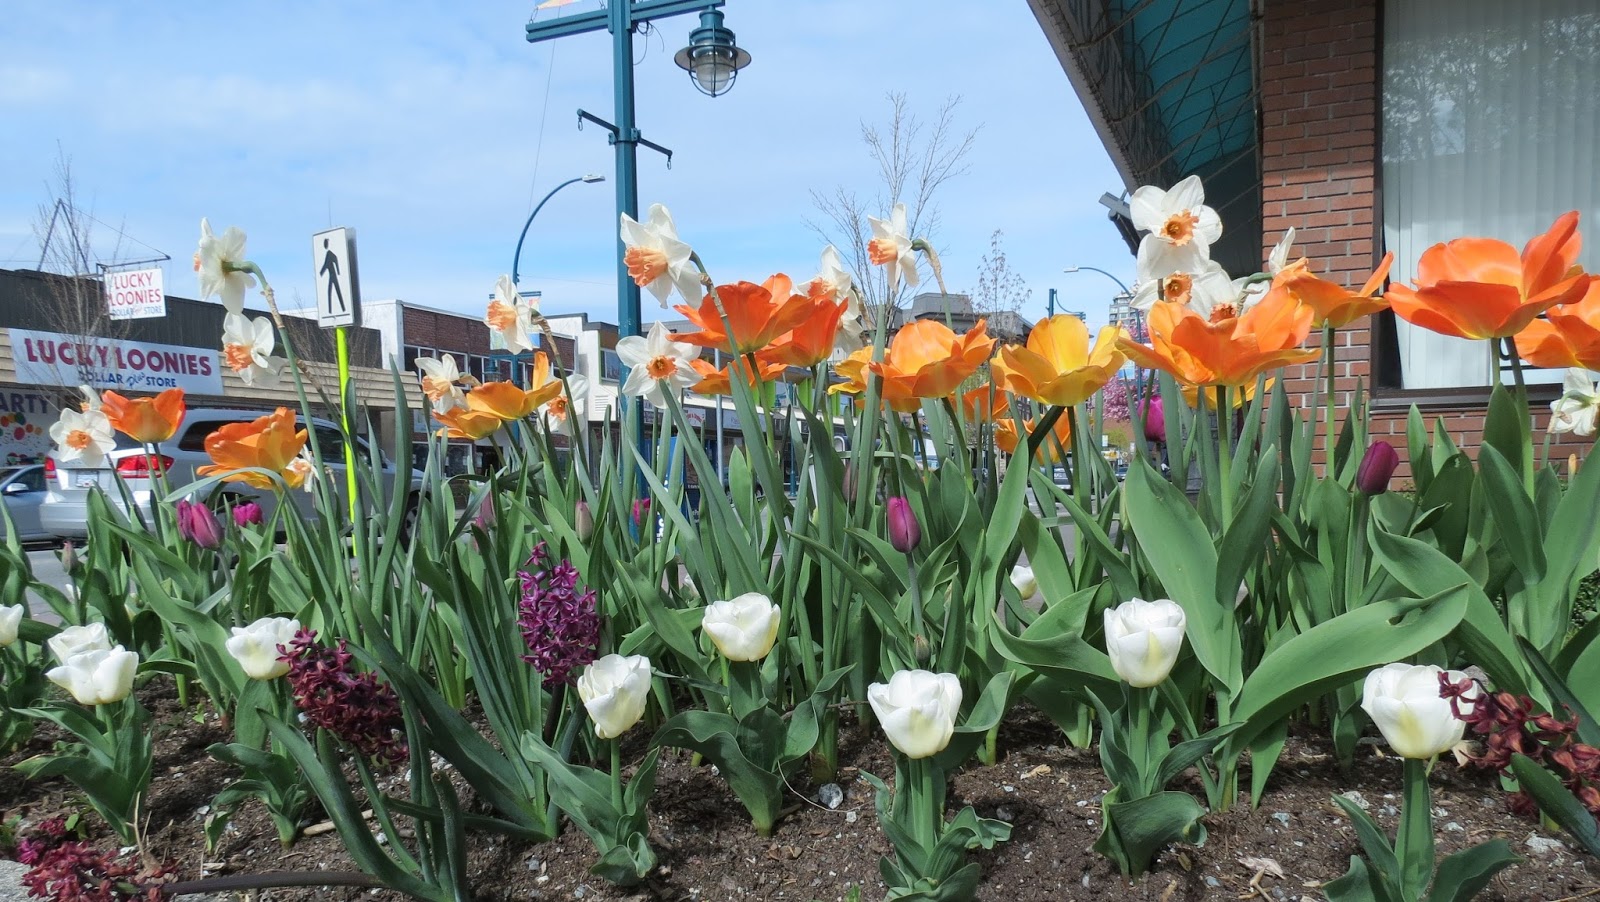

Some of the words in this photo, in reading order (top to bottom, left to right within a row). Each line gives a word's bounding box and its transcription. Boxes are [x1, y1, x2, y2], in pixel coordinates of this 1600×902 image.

[114, 272, 153, 290] LUCKY
[110, 288, 162, 306] LOONIES
[144, 305, 163, 315] STORE
[24, 338, 108, 368] LUCKY
[114, 346, 212, 377] LOONIES
[79, 370, 124, 384] DOLLAR
[146, 376, 177, 388] STORE
